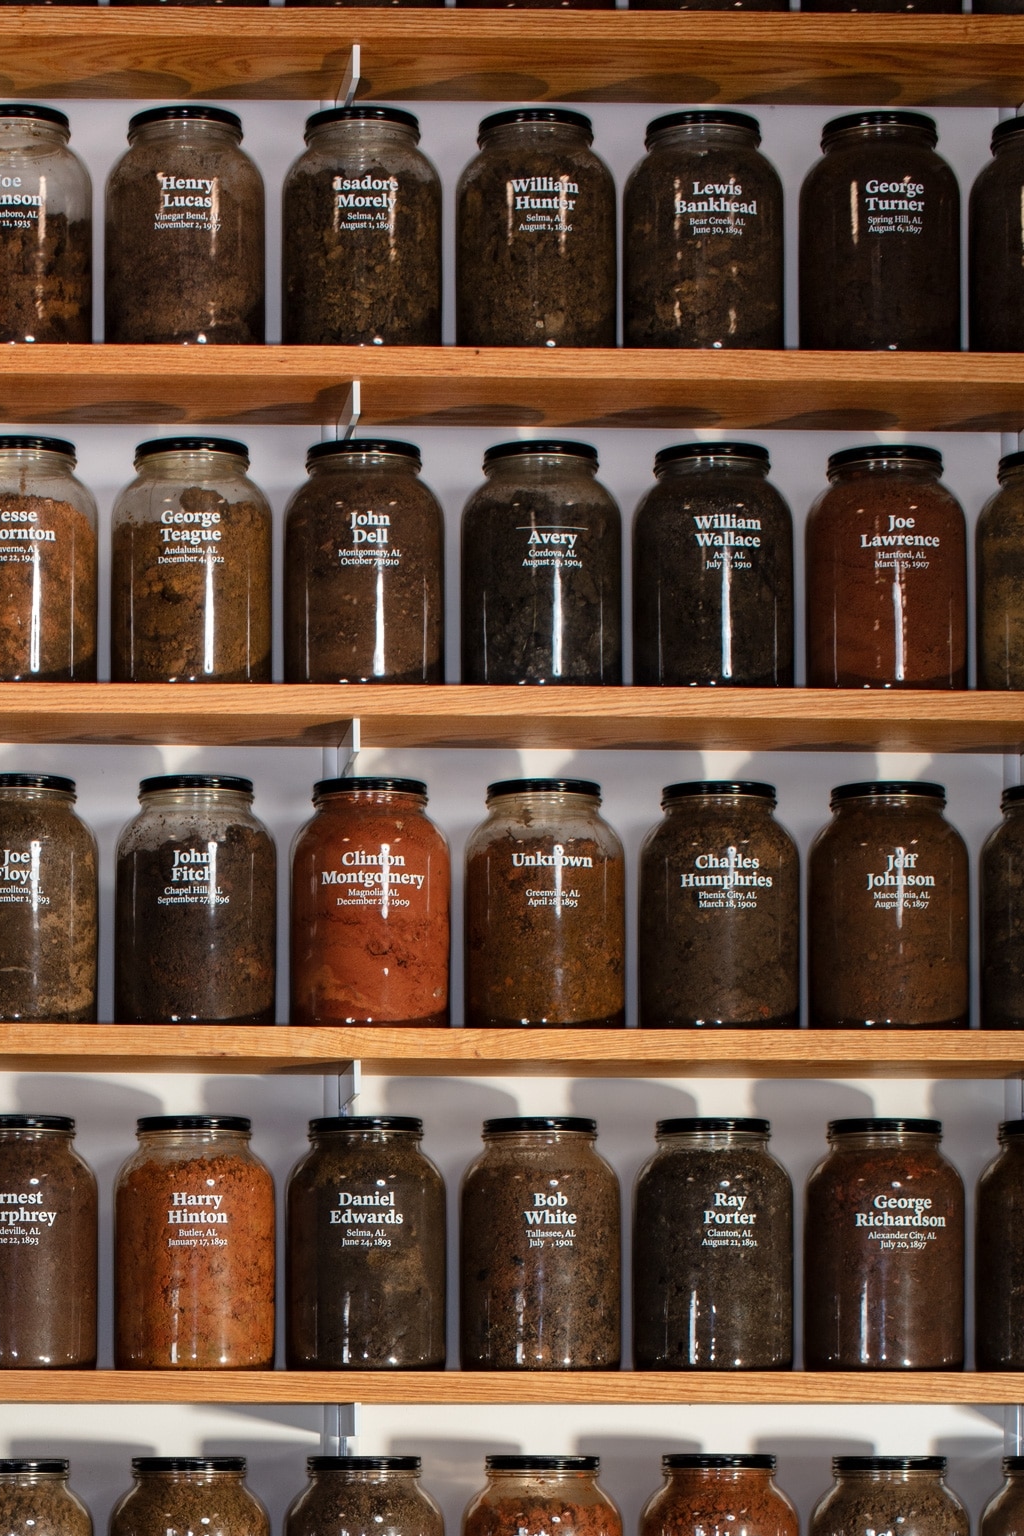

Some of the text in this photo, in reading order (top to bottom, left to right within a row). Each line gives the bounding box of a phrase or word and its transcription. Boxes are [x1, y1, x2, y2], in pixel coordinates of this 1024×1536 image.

[865, 179, 924, 197] George
[865, 197, 924, 212] Turner
[867, 215, 922, 224] Spring Hill, AL
[868, 224, 922, 234] August 6, 1897
[888, 515, 915, 532] Joe
[861, 534, 940, 548] Lawrence
[878, 551, 926, 560] Hartford, AL
[3, 849, 30, 866] Joe
[695, 854, 760, 869] Charles
[680, 871, 773, 890] Humphries
[698, 890, 757, 900] Phenix City, AL
[699, 899, 757, 909] March 18, 1900
[714, 1193, 747, 1210] Ray
[704, 1210, 756, 1224] Porter
[29, 1227, 41, 1235] AL
[9, 1237, 20, 1245] 22,
[21, 1236, 39, 1246] 1893
